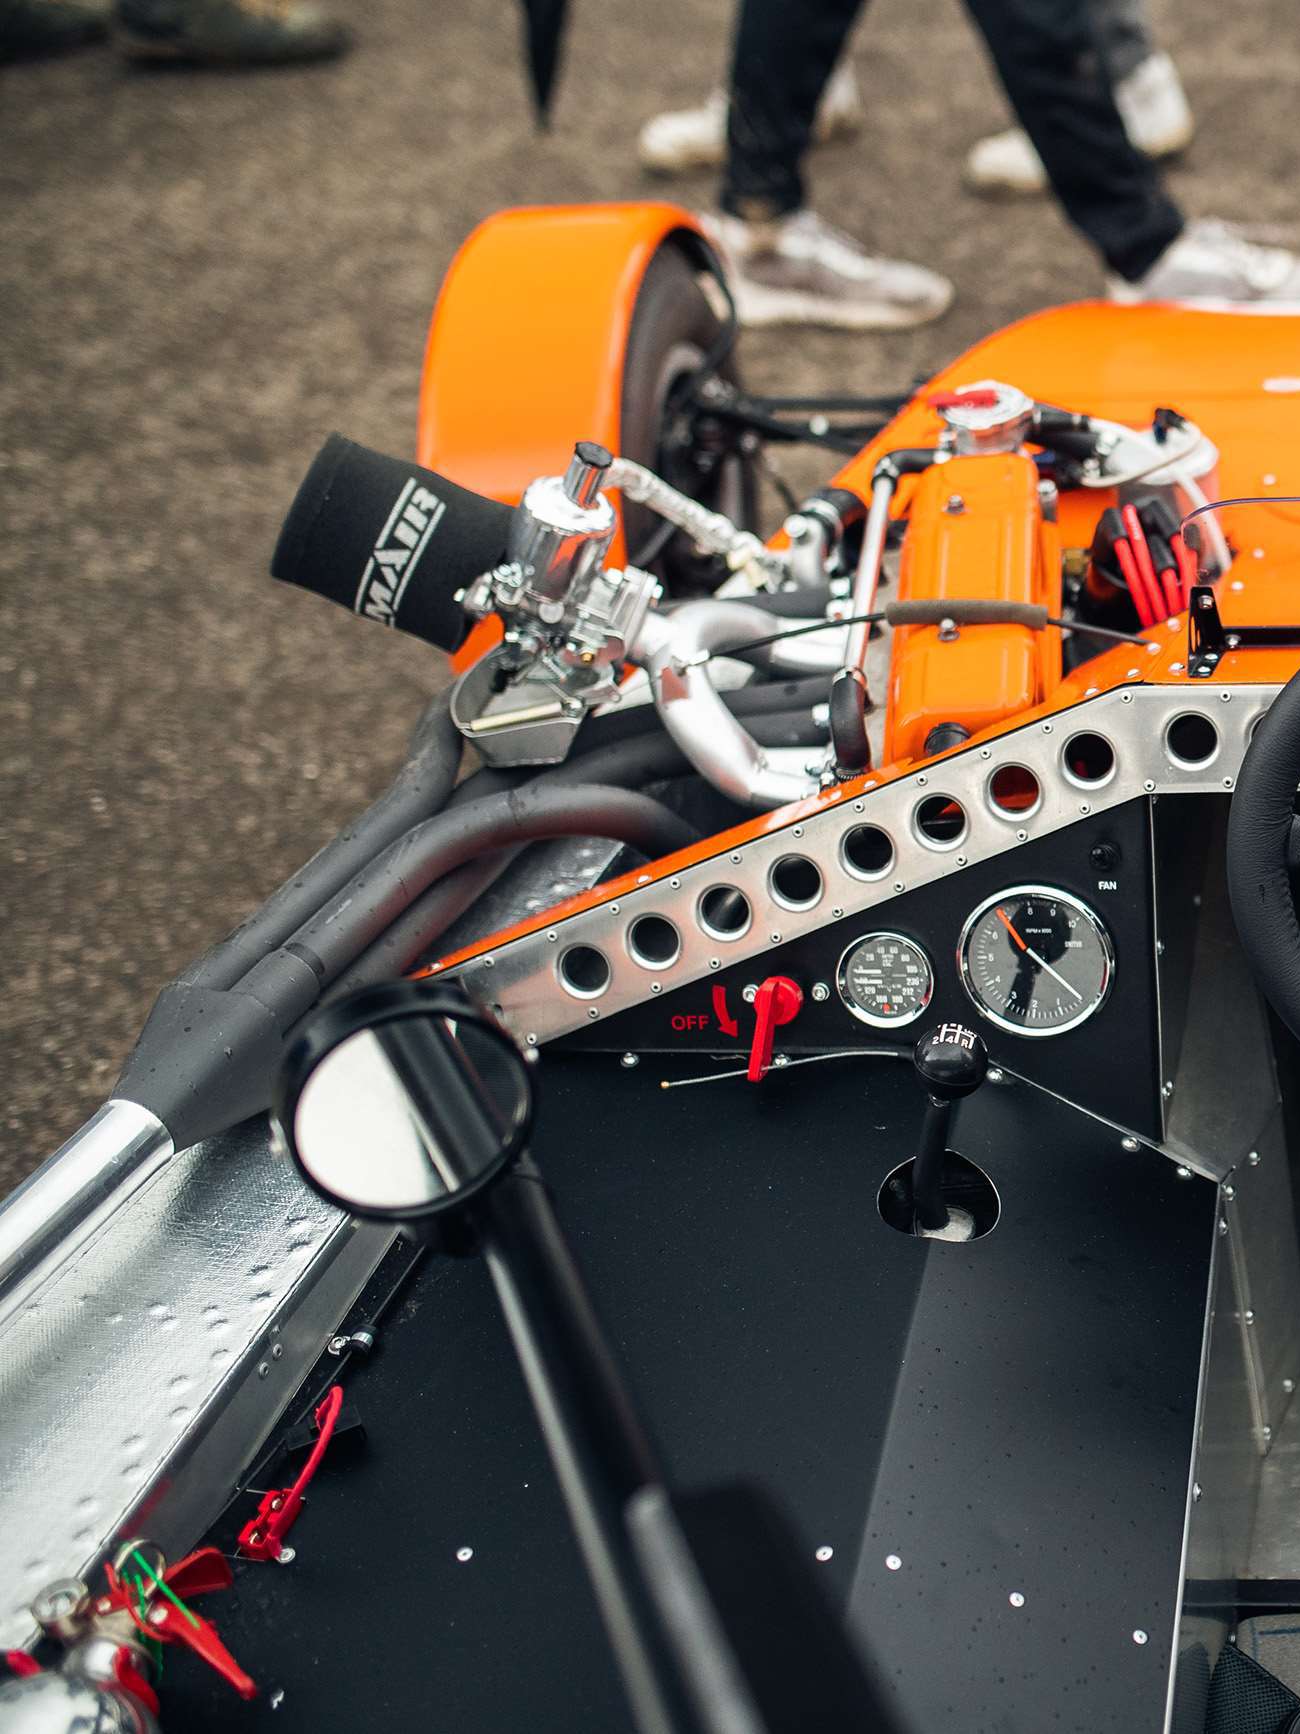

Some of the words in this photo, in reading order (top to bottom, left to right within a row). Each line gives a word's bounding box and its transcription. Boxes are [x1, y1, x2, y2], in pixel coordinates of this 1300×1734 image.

[1098, 881, 1117, 890] FAN
[1027, 907, 1033, 916] 8
[1050, 908, 1056, 917] 9
[1068, 920, 1077, 929] 10
[992, 930, 999, 940] 6
[988, 953, 994, 962] 5
[1011, 991, 1017, 999] 3
[1032, 1000, 1038, 1008] 2
[671, 1015, 709, 1031] OFF
[932, 1036, 940, 1045] 2
[945, 1035, 954, 1044] 4
[961, 1039, 969, 1049] R
